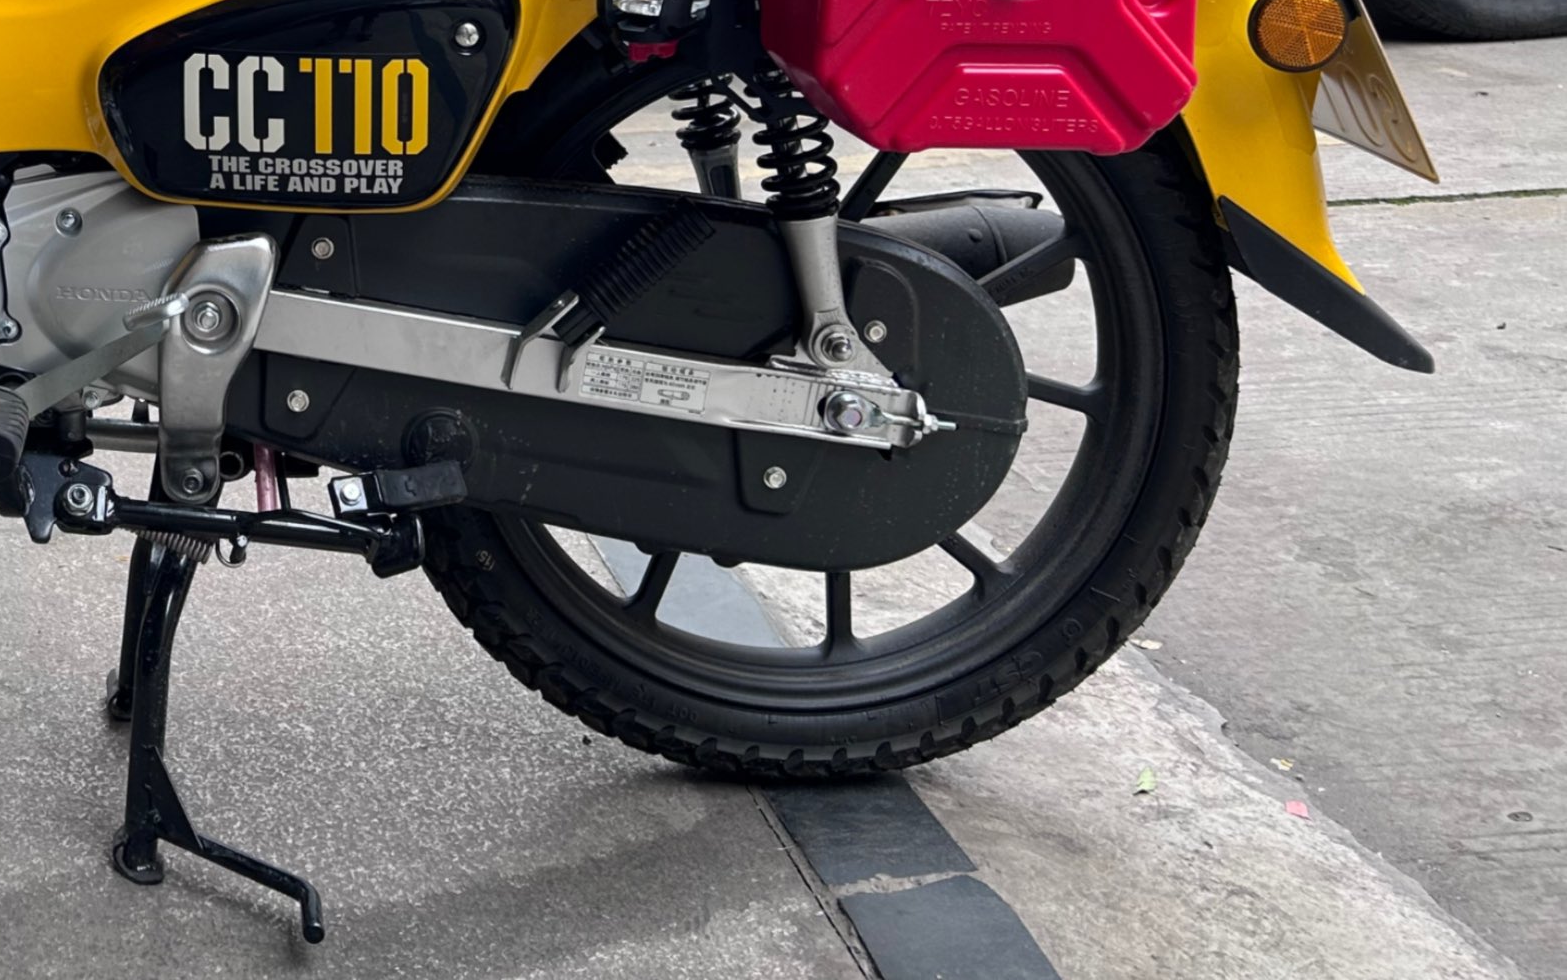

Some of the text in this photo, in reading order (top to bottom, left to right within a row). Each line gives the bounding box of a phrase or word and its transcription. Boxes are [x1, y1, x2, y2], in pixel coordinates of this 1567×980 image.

[953, 87, 1071, 108] GASOLINE
[208, 155, 404, 177] THE CROSSOVER
[209, 173, 404, 194] A LIFE AND PLAY
[56, 286, 153, 303] HONDA
